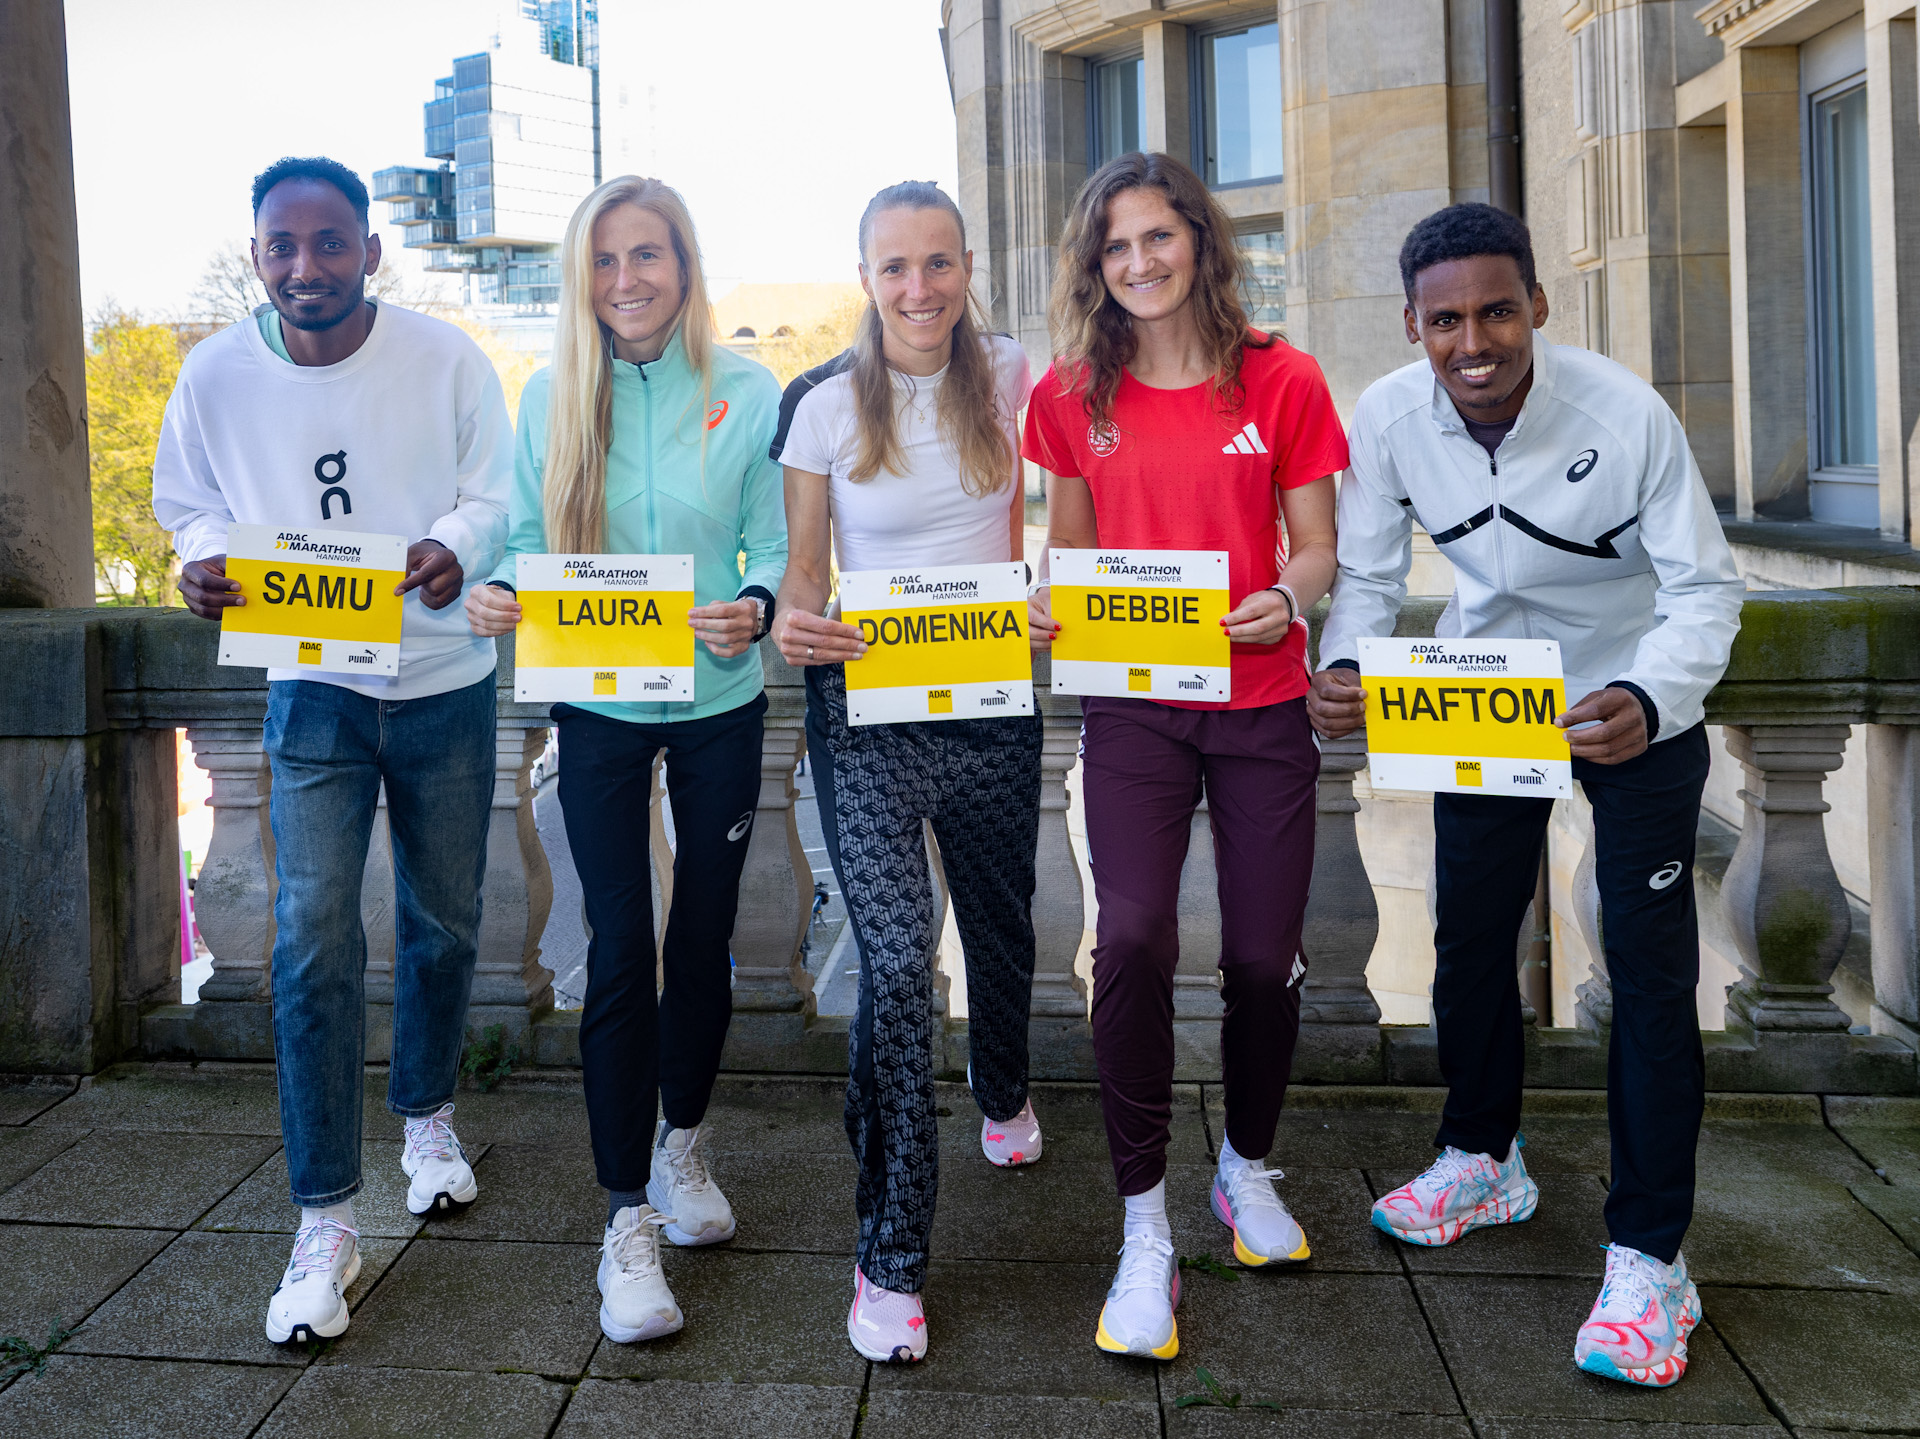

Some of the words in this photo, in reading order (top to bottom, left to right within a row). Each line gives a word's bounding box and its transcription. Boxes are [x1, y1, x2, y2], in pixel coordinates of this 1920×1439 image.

[277, 532, 308, 542] ADAC
[289, 541, 361, 555] MARATHON
[316, 553, 361, 563] HANNOVER
[1096, 556, 1127, 565] ADAC
[564, 561, 594, 569] ADAC
[577, 569, 648, 578] MARATHON
[1109, 565, 1181, 575] MARATHON
[889, 575, 921, 585] ADAC
[1136, 575, 1182, 583] HANNOVER
[262, 570, 373, 611] SAMU
[903, 581, 978, 594] MARATHON
[932, 591, 979, 600] HANNOVER
[558, 599, 662, 626] LAURA
[1086, 593, 1200, 624] DEBBIE
[858, 609, 1022, 646] DOMENIKA
[299, 642, 322, 651] ADAC
[1410, 645, 1444, 654] ADAC
[348, 655, 374, 664] PUMA
[1425, 654, 1507, 664] MARATHON
[594, 672, 616, 680] ADAC
[1128, 668, 1151, 677] ADAC
[644, 682, 668, 690] PUMA
[1178, 680, 1204, 690] PUMA
[928, 690, 951, 699] ADAC
[980, 697, 1006, 706] PUMA
[1379, 687, 1556, 725] HAFTOM
[1456, 762, 1481, 771] ADAC
[1513, 775, 1542, 785] PUMA
